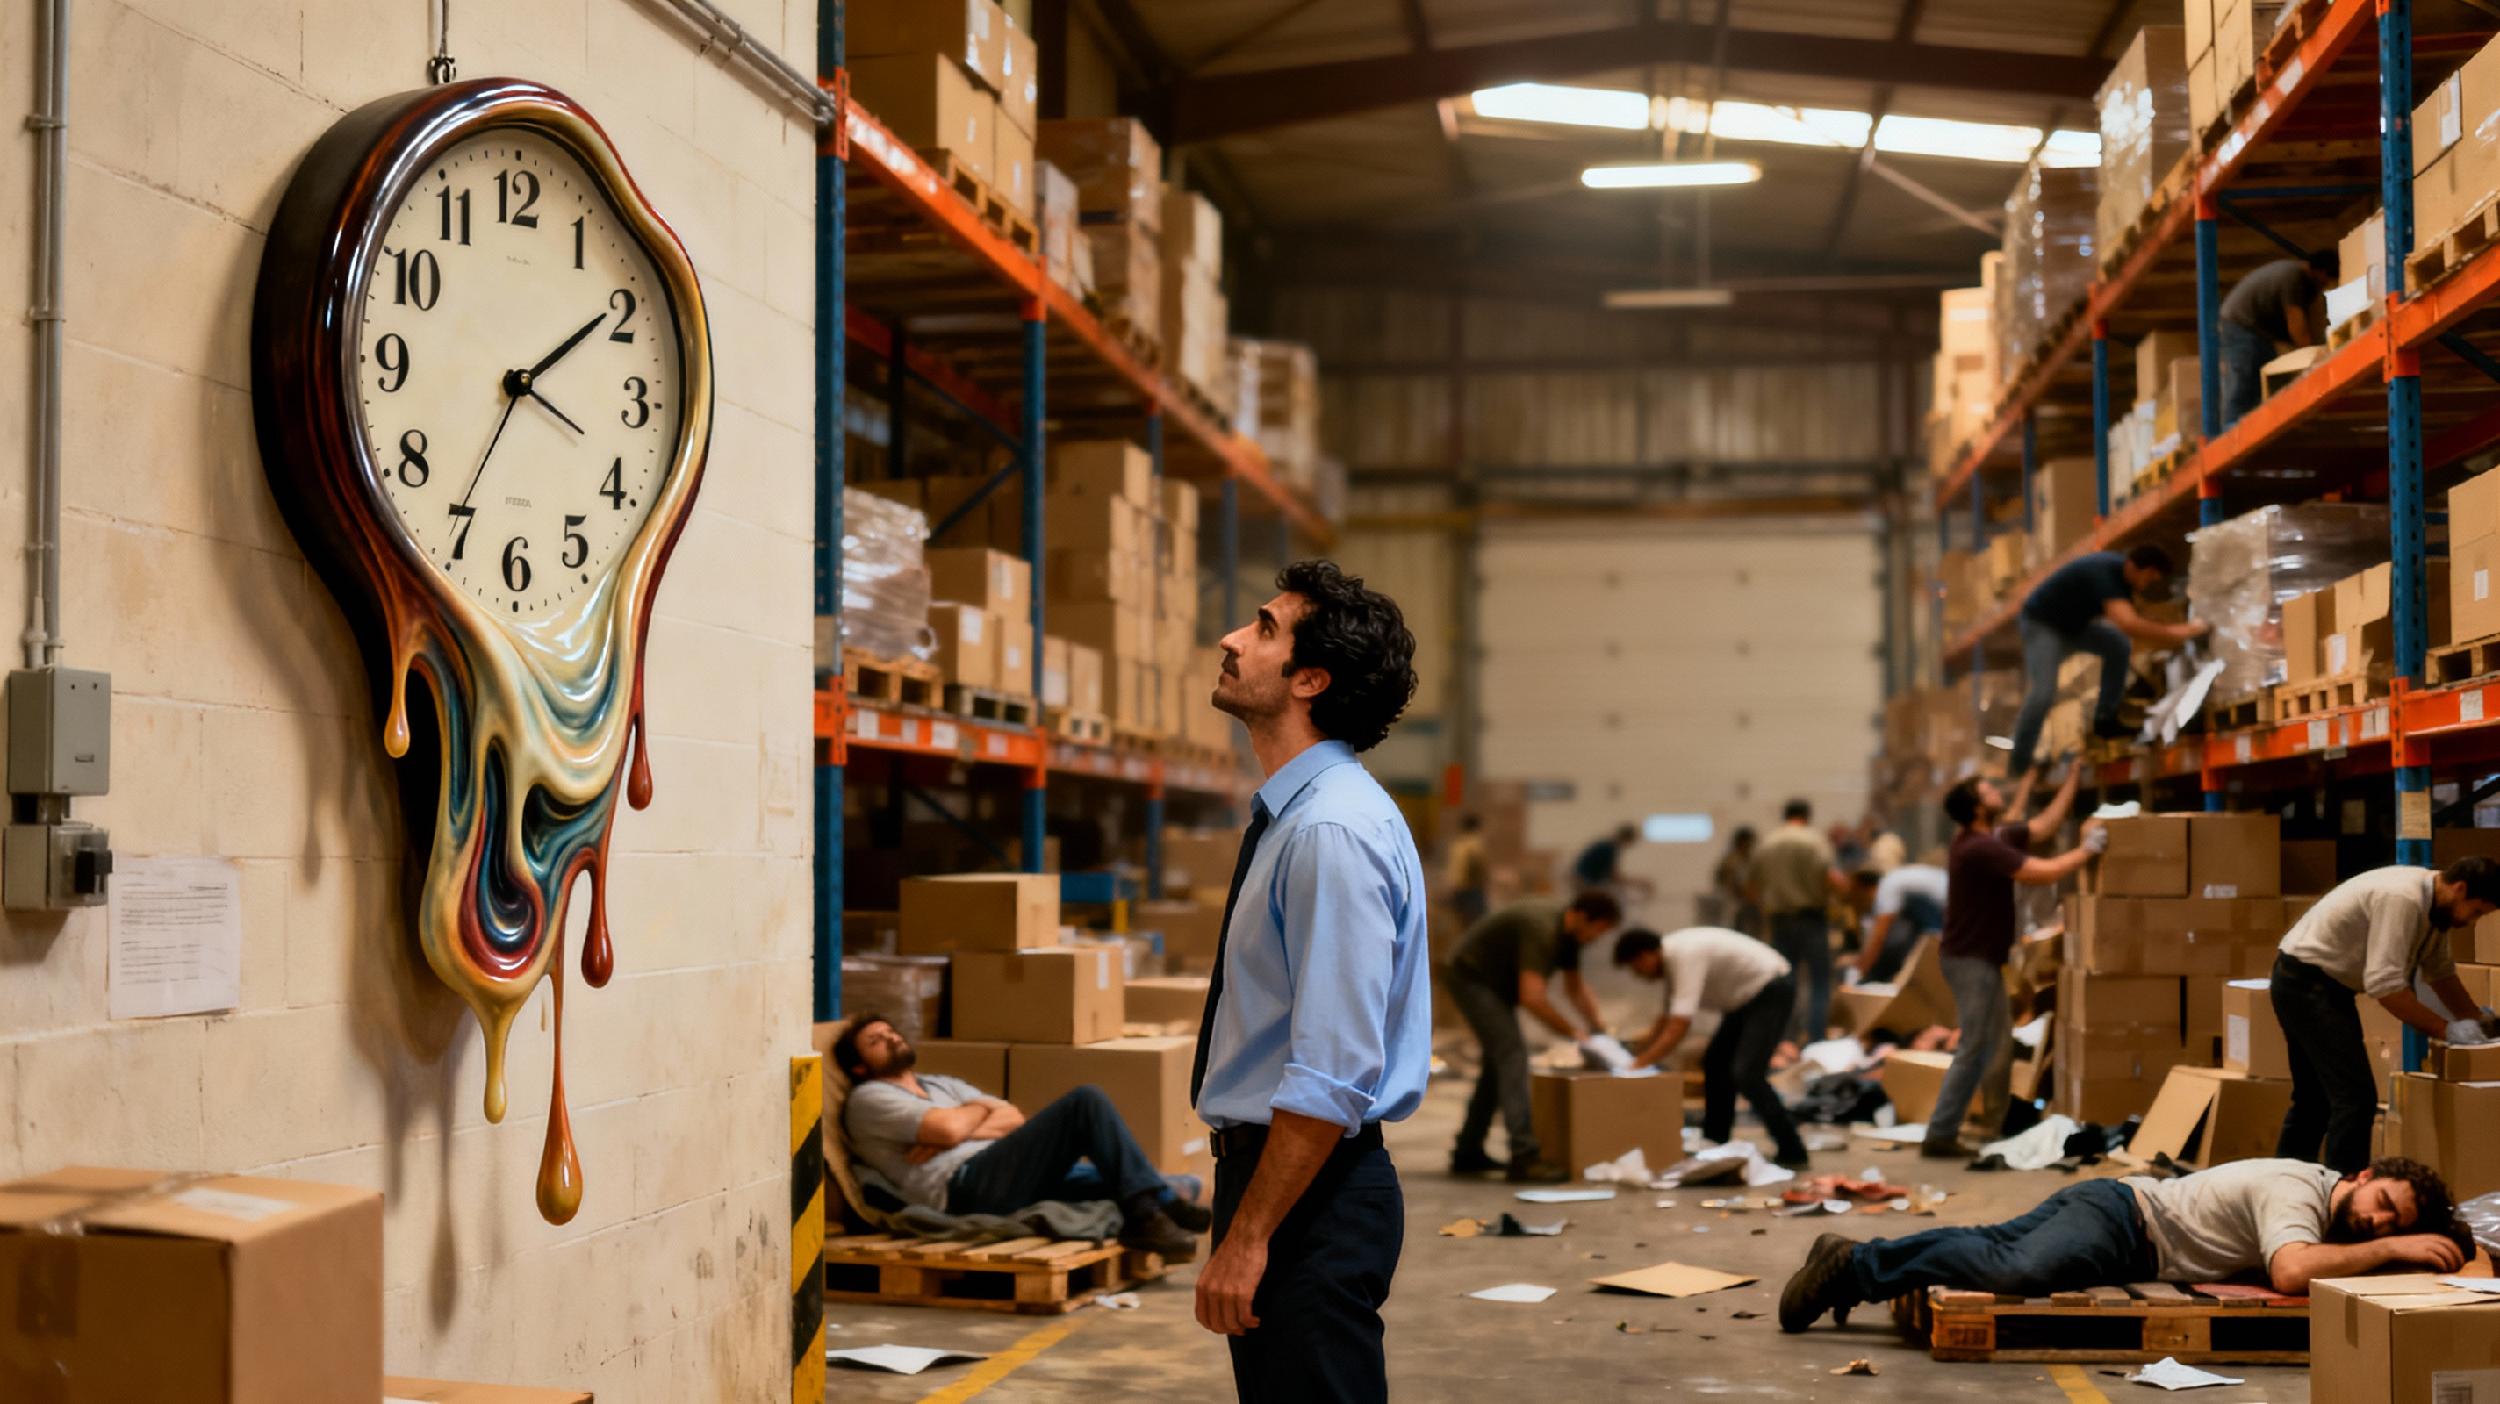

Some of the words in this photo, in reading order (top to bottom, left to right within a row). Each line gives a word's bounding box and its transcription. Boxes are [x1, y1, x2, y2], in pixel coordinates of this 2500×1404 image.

[436, 184, 471, 247] 11
[492, 167, 541, 229] 12
[570, 215, 585, 270] 1
[391, 247, 441, 312] 10
[608, 287, 637, 345] 2
[375, 332, 410, 393] 9
[621, 376, 650, 429] 3
[398, 429, 430, 489] 8
[599, 456, 628, 511] 4
[448, 503, 477, 560] 7
[561, 514, 589, 569] 5
[501, 536, 532, 592] 6
